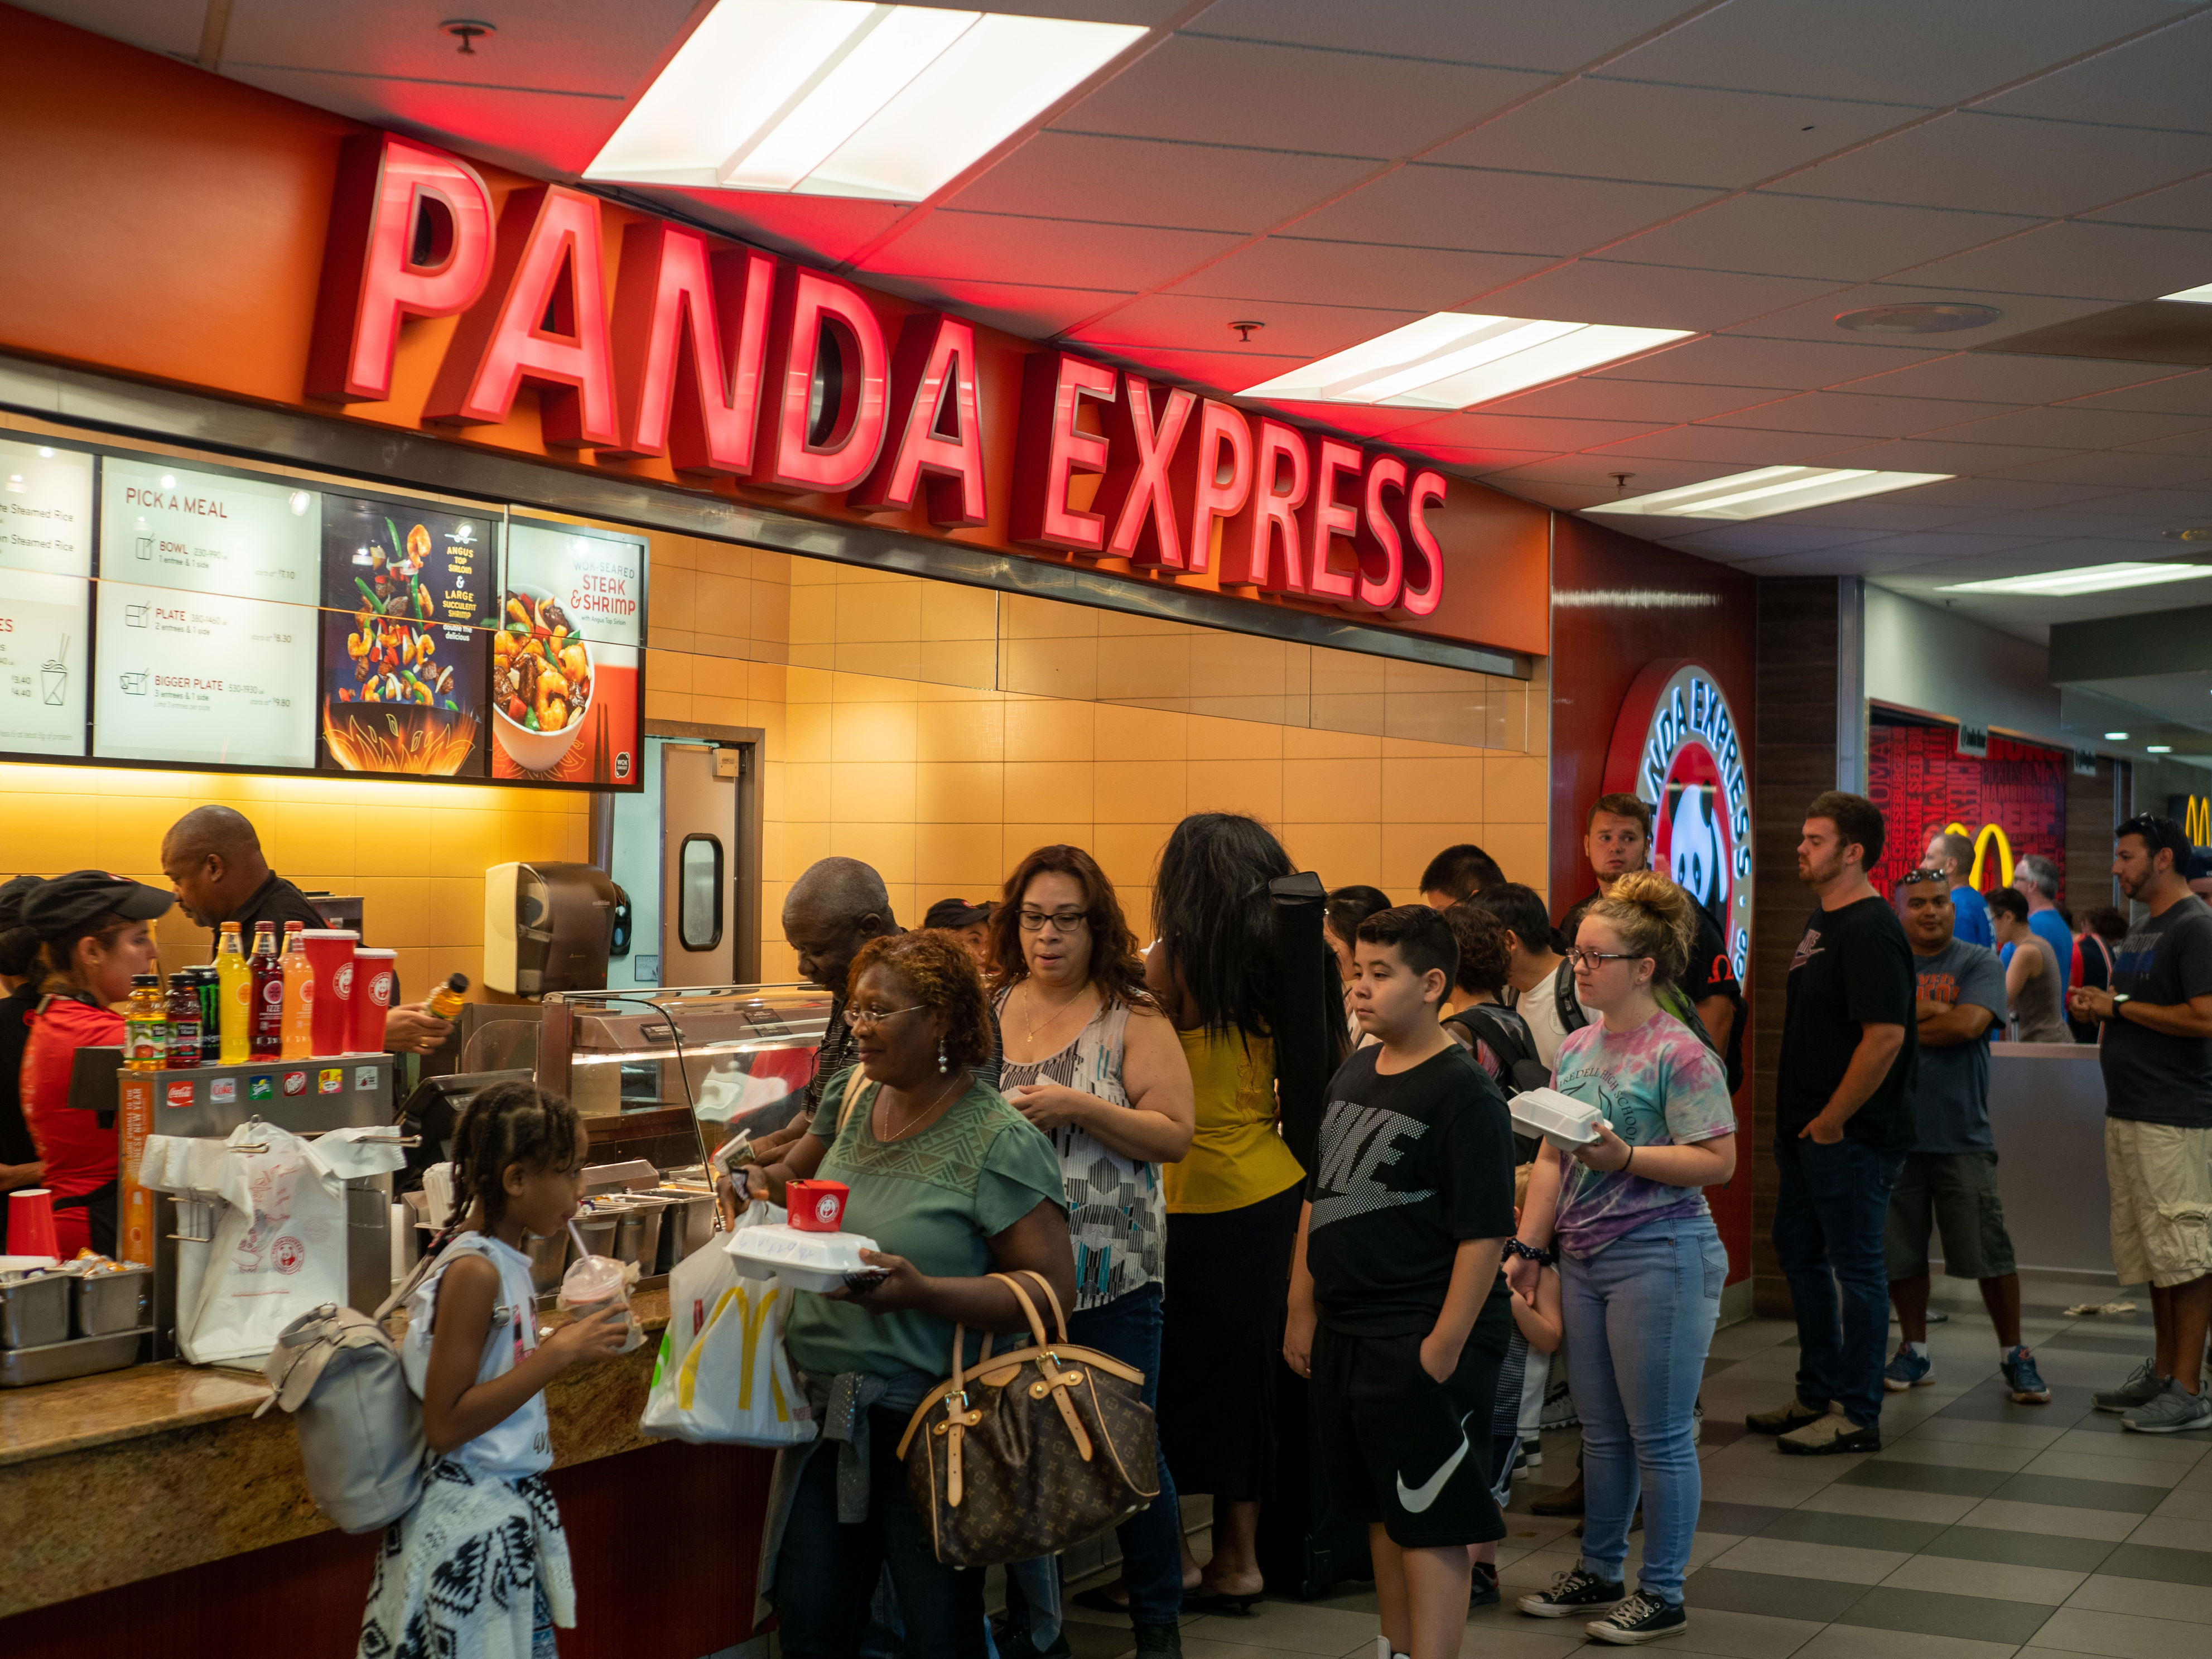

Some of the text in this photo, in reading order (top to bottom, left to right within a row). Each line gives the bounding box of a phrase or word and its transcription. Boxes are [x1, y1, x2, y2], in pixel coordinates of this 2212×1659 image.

[343, 132, 1448, 618] PANDA EXPRESS
[127, 487, 227, 518] PICK A MEAL
[11, 503, 51, 518] Steamed
[54, 510, 74, 522] Rice
[11, 534, 51, 548] Steamed
[55, 540, 74, 552] Rice
[160, 541, 189, 554] BOWL
[446, 546, 474, 558] ANGUS
[448, 564, 473, 575] SIRLOIN
[454, 556, 468, 565] TOP
[574, 561, 634, 579] WOK-SEARED
[455, 575, 465, 589] &
[583, 573, 625, 596] STEAK
[445, 590, 474, 602] LARGE
[570, 589, 636, 616] & SHRIMP
[156, 608, 186, 621] PLATE
[442, 600, 477, 611] SUCCULENT
[448, 610, 471, 619] SHRIMP
[445, 631, 470, 642] delicious
[155, 676, 191, 688] BIGGER
[194, 679, 224, 691] PLATE
[1689, 676, 1751, 881] EXPRESS
[1906, 754, 1923, 793] SEED
[1981, 802, 2055, 834] BEEF
[1905, 797, 1922, 860] SESAME
[213, 1084, 233, 1095] Coke
[1600, 1069, 1620, 1092] HIGH
[132, 1088, 142, 1111] YEAR
[132, 1113, 142, 1133] NEW
